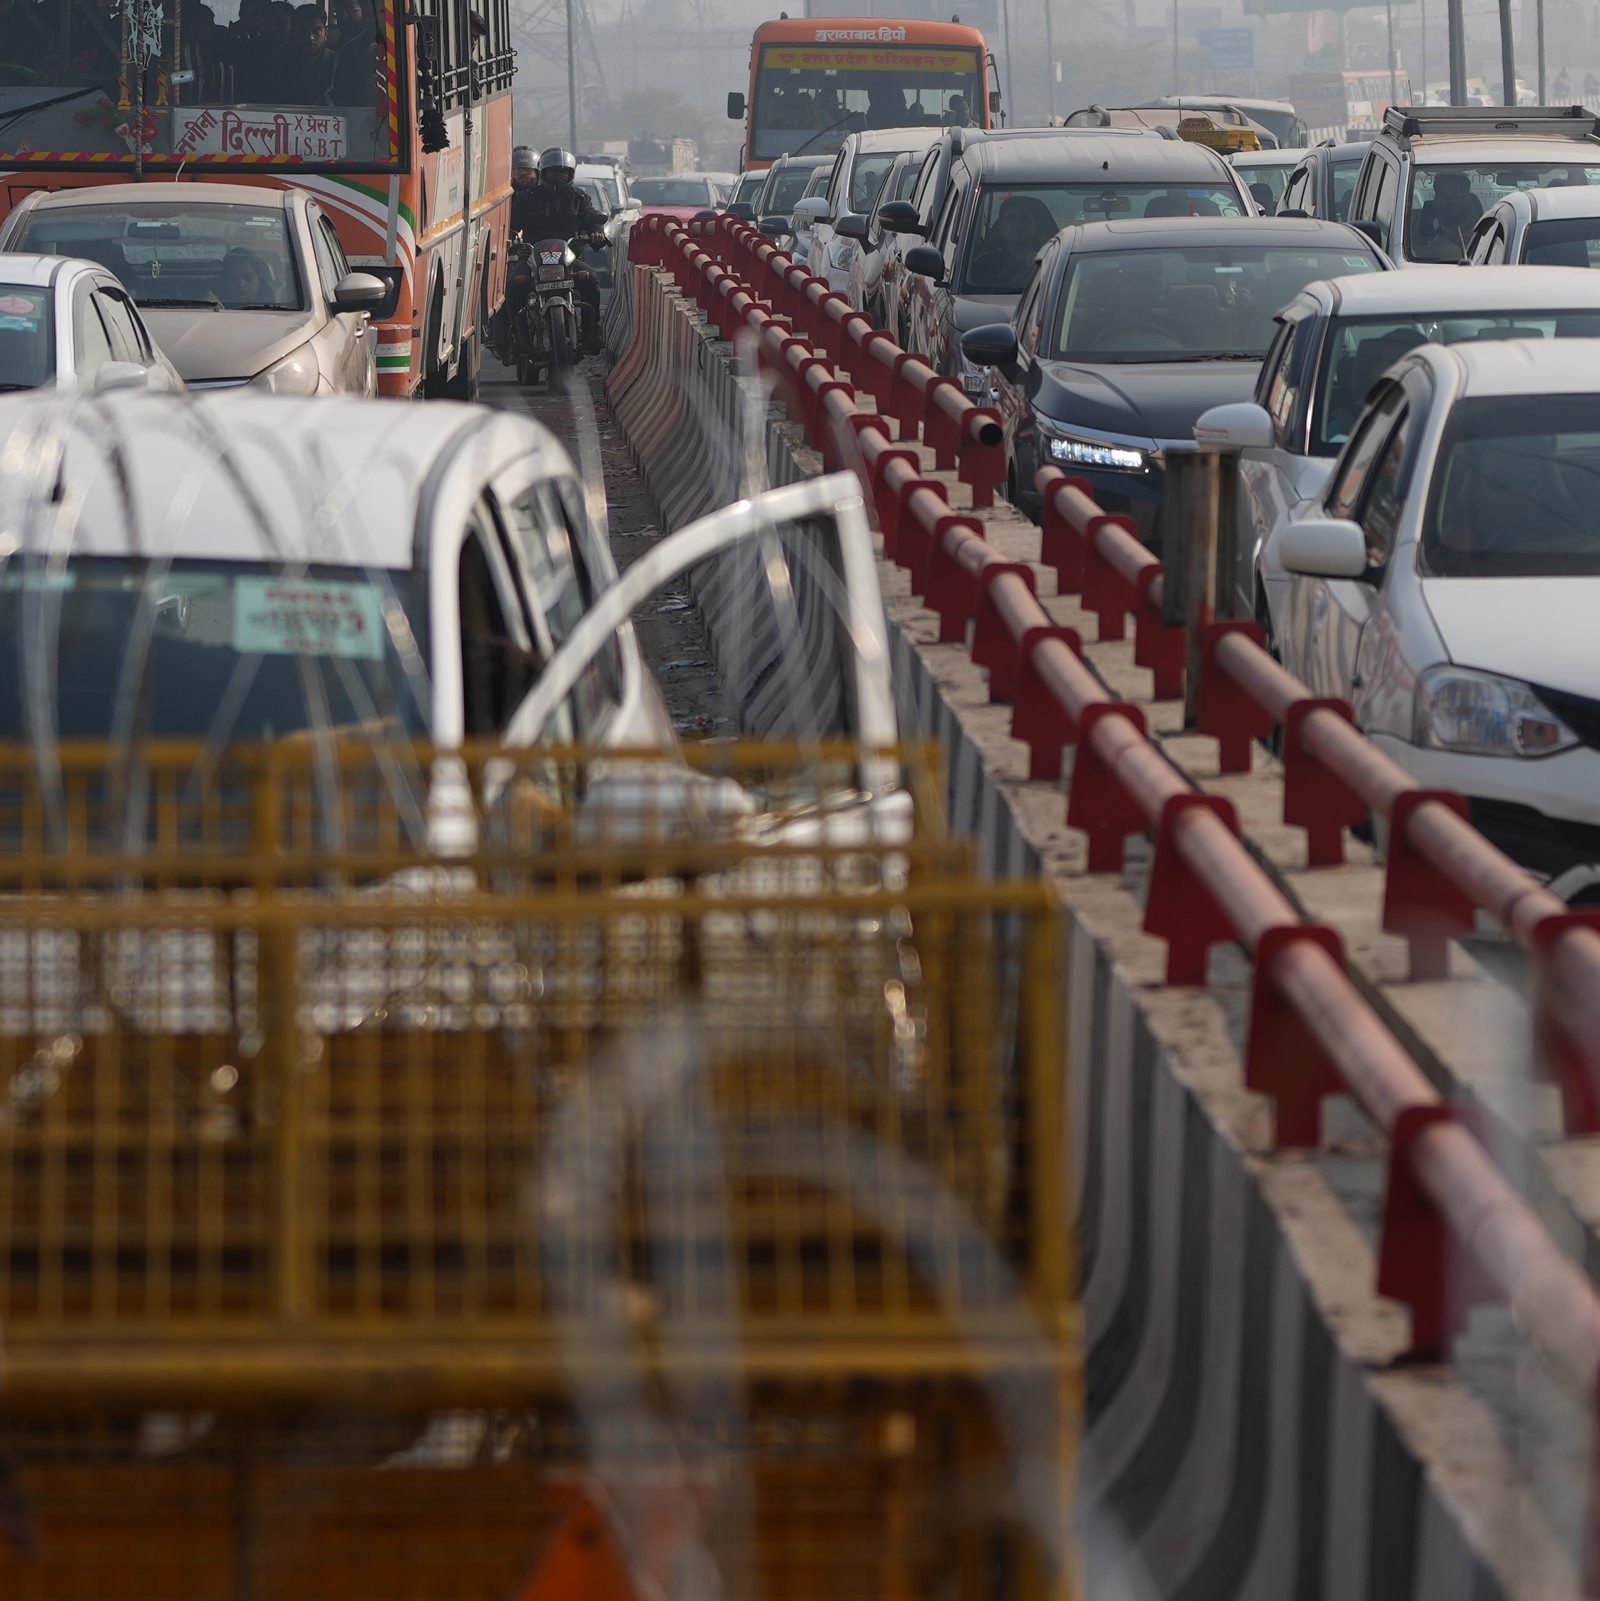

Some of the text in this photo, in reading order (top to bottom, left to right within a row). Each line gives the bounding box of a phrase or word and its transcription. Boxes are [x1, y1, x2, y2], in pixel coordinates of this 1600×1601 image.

[878, 26, 907, 41] डिपो
[802, 53, 831, 64] उत्तर
[834, 50, 867, 66] प्रदेश
[220, 111, 292, 156] दिल्ली
